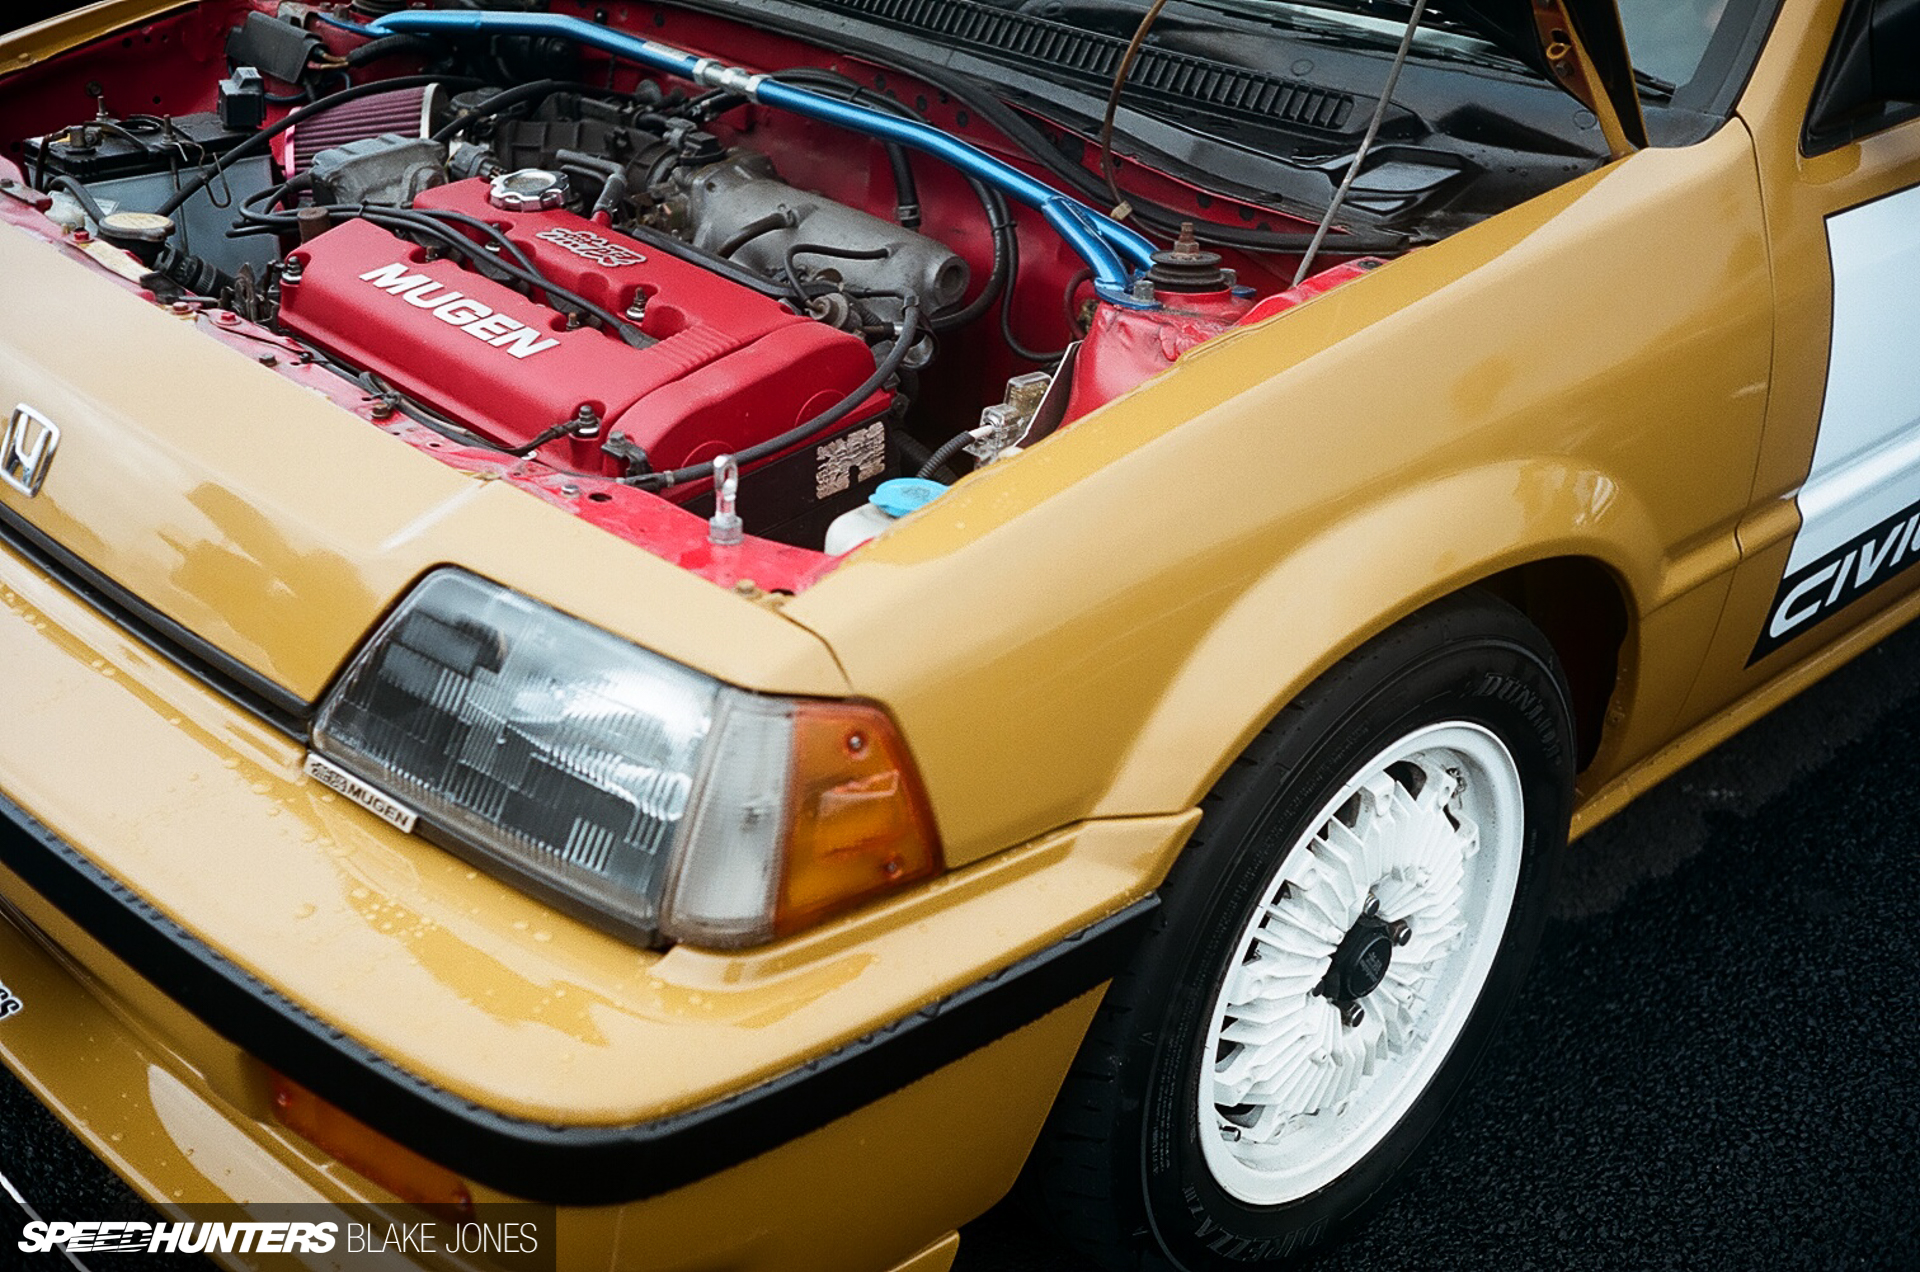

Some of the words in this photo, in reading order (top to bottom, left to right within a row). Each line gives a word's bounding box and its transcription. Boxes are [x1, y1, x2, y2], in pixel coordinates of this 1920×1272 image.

[359, 262, 561, 359] MUGEN
[1769, 513, 1920, 638] CIVI
[347, 783, 410, 827] MUGEN
